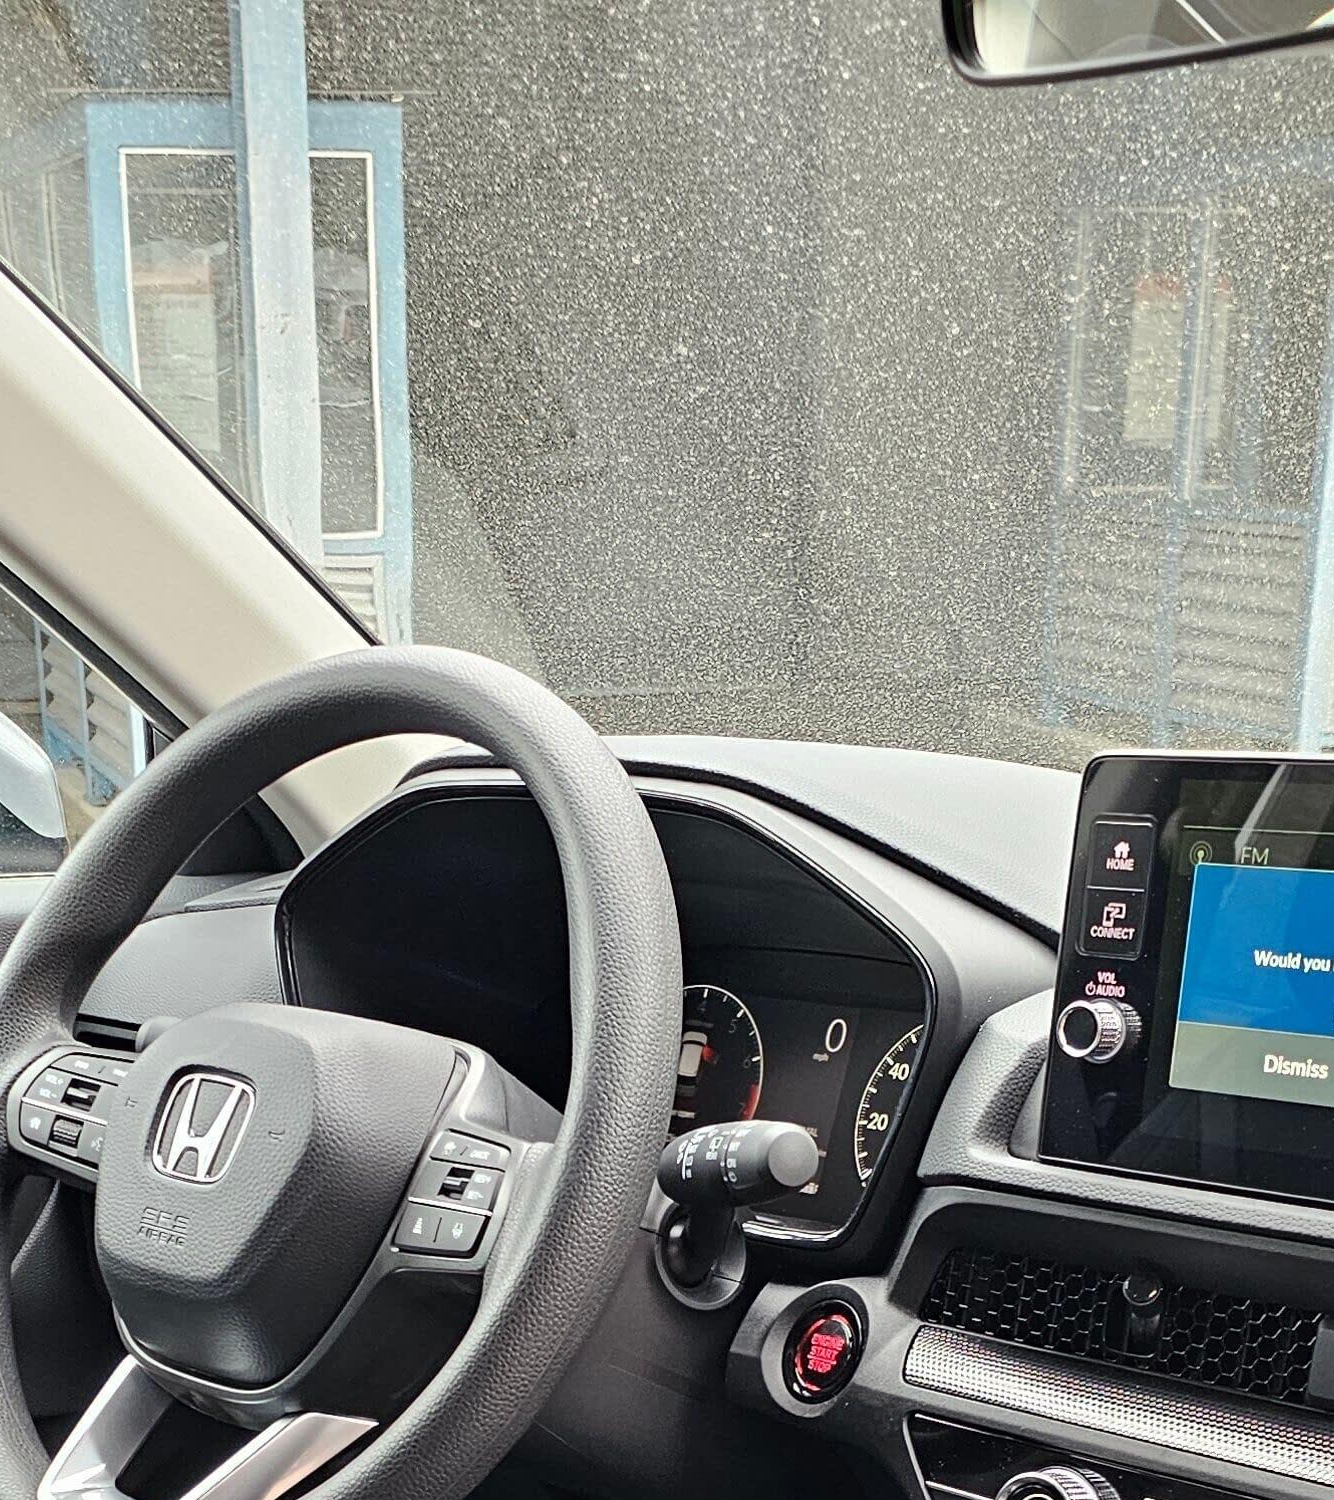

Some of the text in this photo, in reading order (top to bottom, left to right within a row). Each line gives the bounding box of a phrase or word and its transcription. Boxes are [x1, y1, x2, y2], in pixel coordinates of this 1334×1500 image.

[1106, 858, 1134, 871] HOME
[1240, 847, 1269, 865] FM
[1090, 925, 1135, 940] CONNECT
[1254, 949, 1302, 970] Would
[1303, 957, 1332, 973] you
[1097, 971, 1117, 984] VOL
[1095, 984, 1126, 997] AUDIO
[825, 1018, 847, 1053] 0
[888, 1062, 910, 1080] 40
[1263, 1054, 1329, 1080] Dismiss
[867, 1112, 888, 1131] 20
[811, 1333, 845, 1351] ENGINE
[809, 1345, 839, 1360] START
[807, 1360, 832, 1373] STOP
